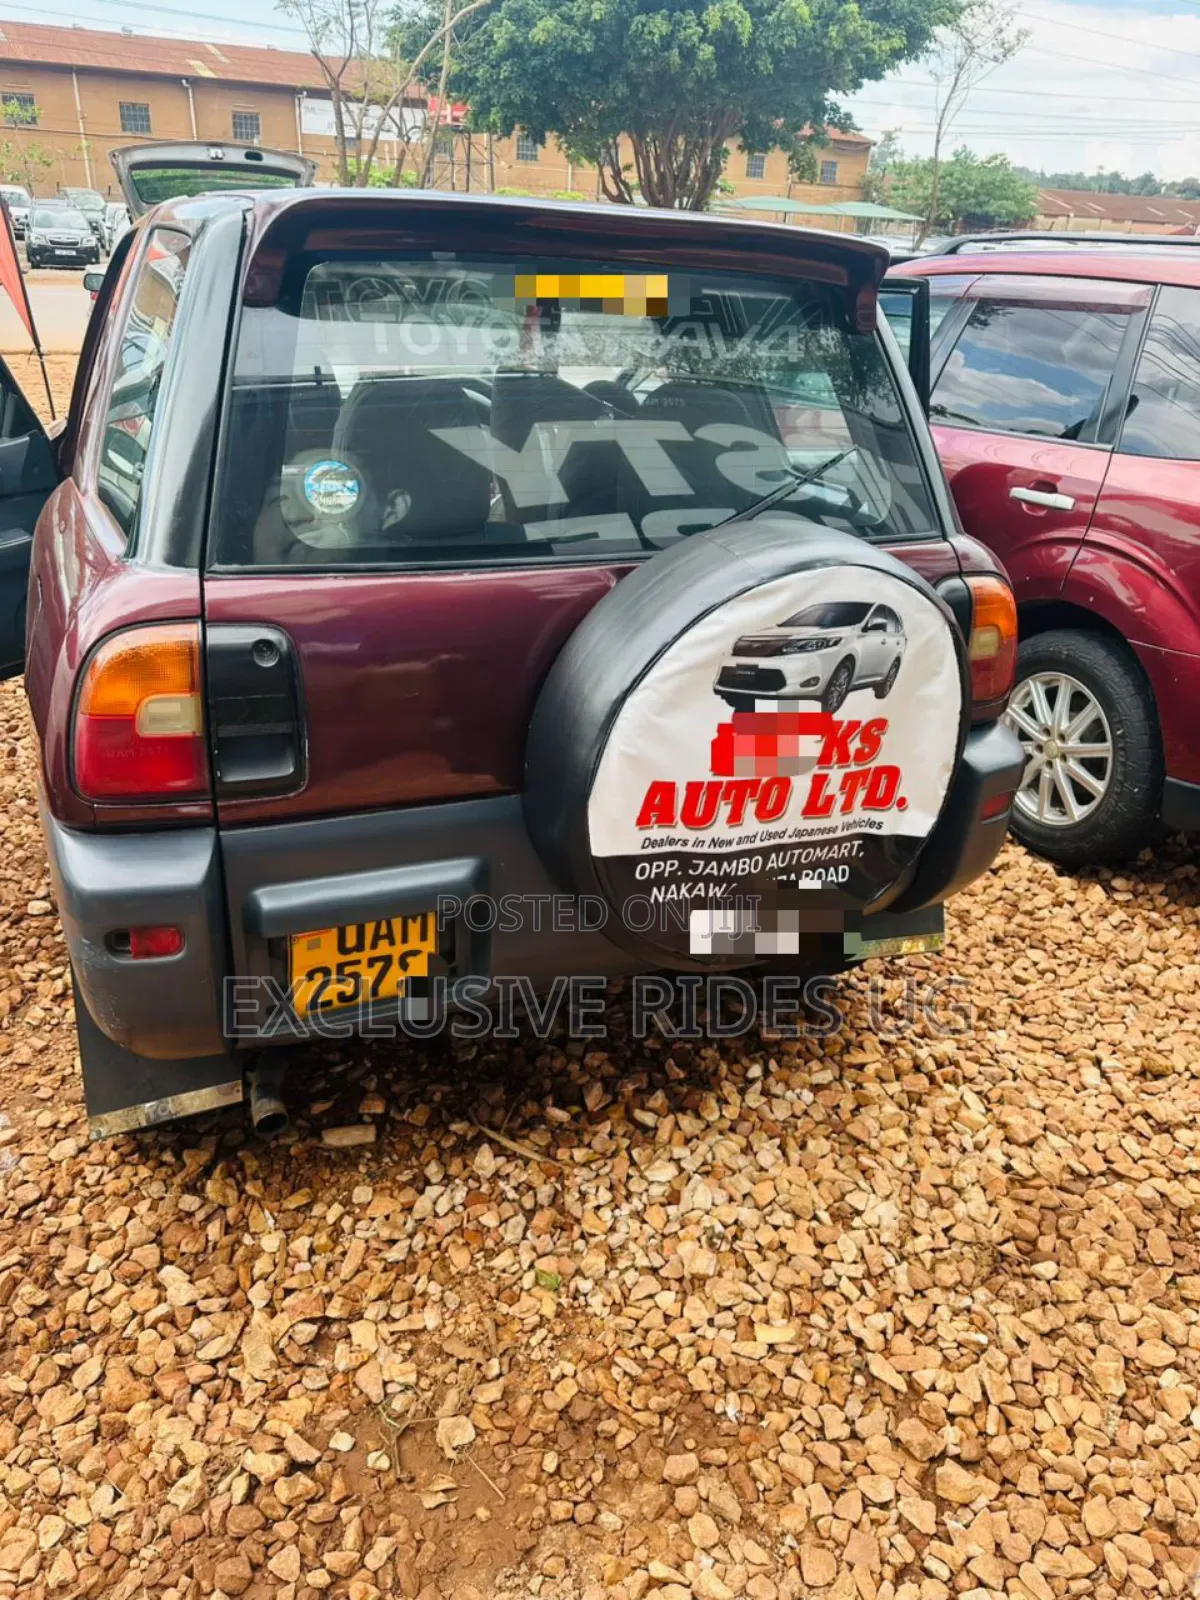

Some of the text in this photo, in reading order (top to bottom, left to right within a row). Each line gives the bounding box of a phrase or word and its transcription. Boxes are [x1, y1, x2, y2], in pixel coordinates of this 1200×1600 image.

[635, 765, 909, 831] AUTO LTD.
[641, 817, 884, 851] Dealers in New and Used Japanese Vehicles
[634, 840, 865, 880] OPP. JAMBO AUTOMART,
[650, 882, 738, 904] NAKAW
